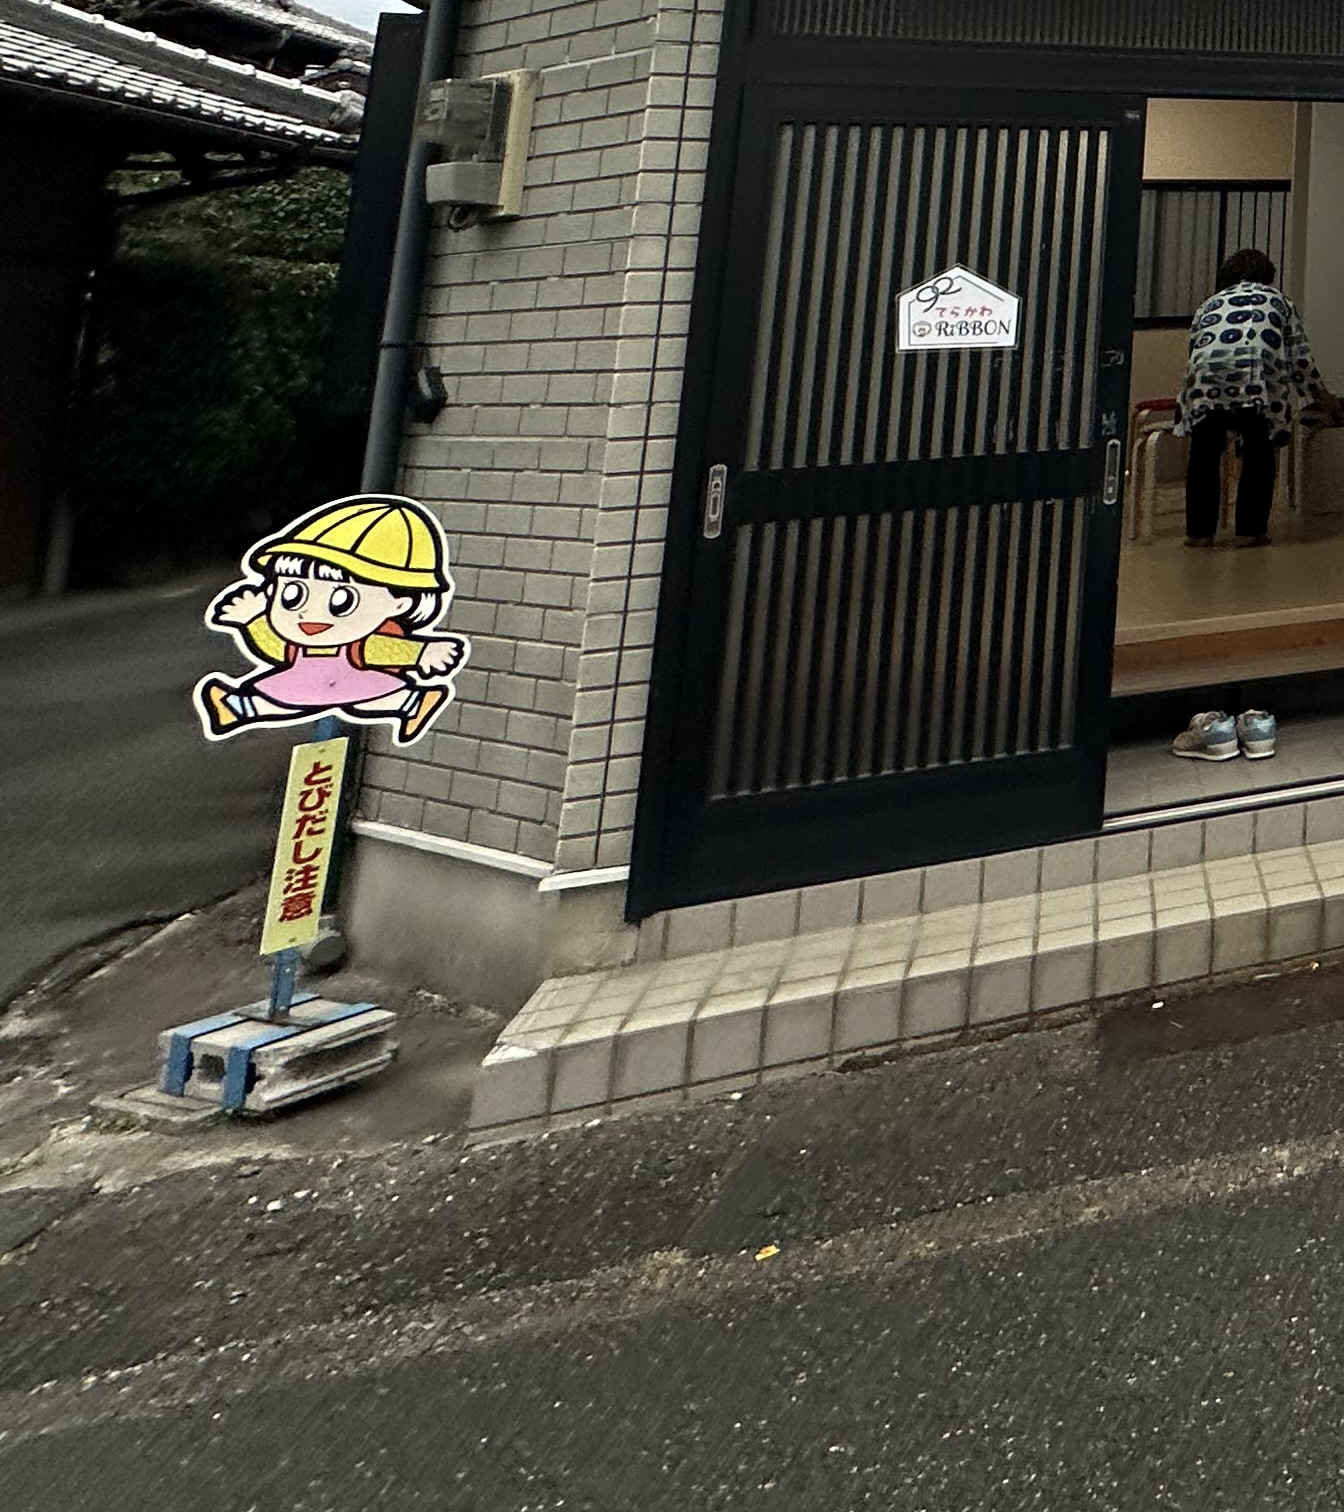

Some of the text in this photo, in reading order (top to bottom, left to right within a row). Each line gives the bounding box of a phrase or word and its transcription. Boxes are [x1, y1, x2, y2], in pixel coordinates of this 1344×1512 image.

[934, 305, 993, 319] てらかわ
[278, 761, 334, 923] とびだし注意
